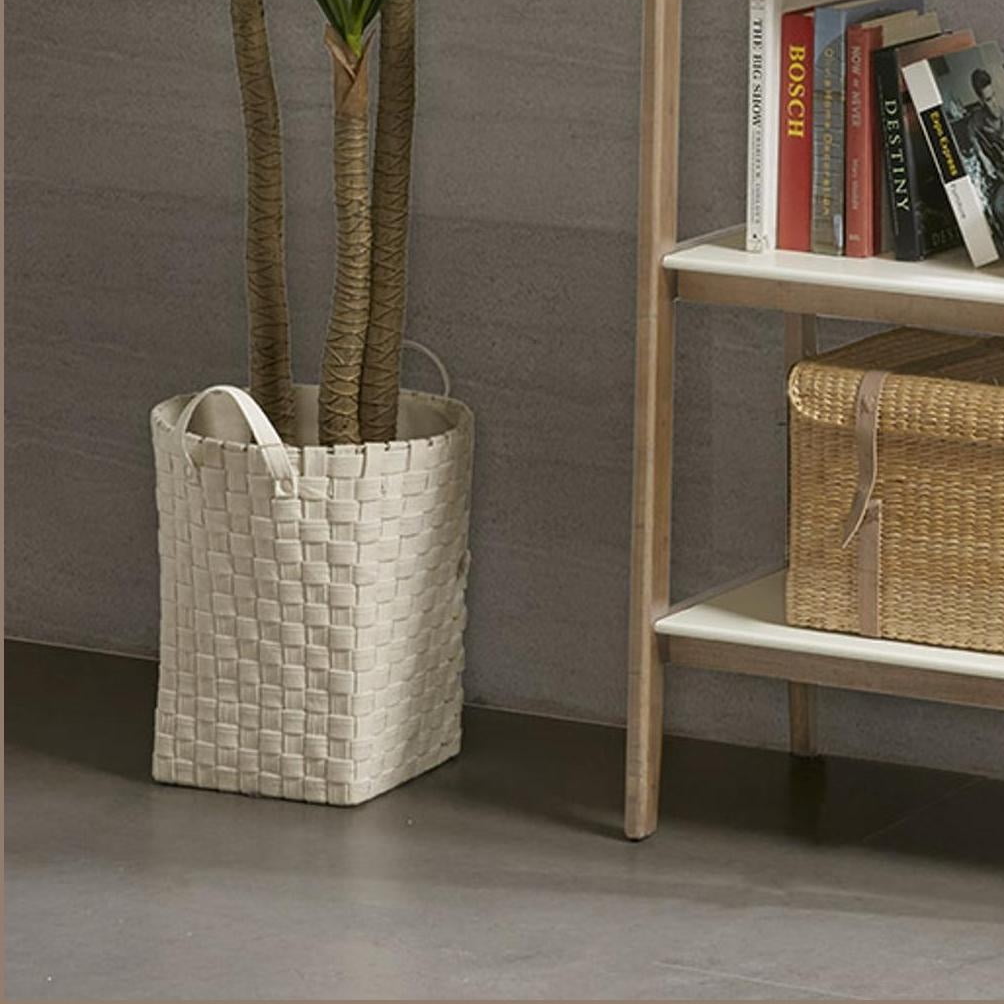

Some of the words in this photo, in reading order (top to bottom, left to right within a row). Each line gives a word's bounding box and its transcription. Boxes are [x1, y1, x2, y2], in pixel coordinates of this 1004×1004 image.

[752, 18, 764, 50] THE
[752, 54, 763, 80] BIG
[851, 46, 861, 75] NOW
[752, 83, 763, 128] SHOW
[787, 45, 806, 138] BOSCH
[851, 91, 861, 127] NEVER
[884, 99, 910, 212] DESTINY
[939, 133, 957, 177] Express
